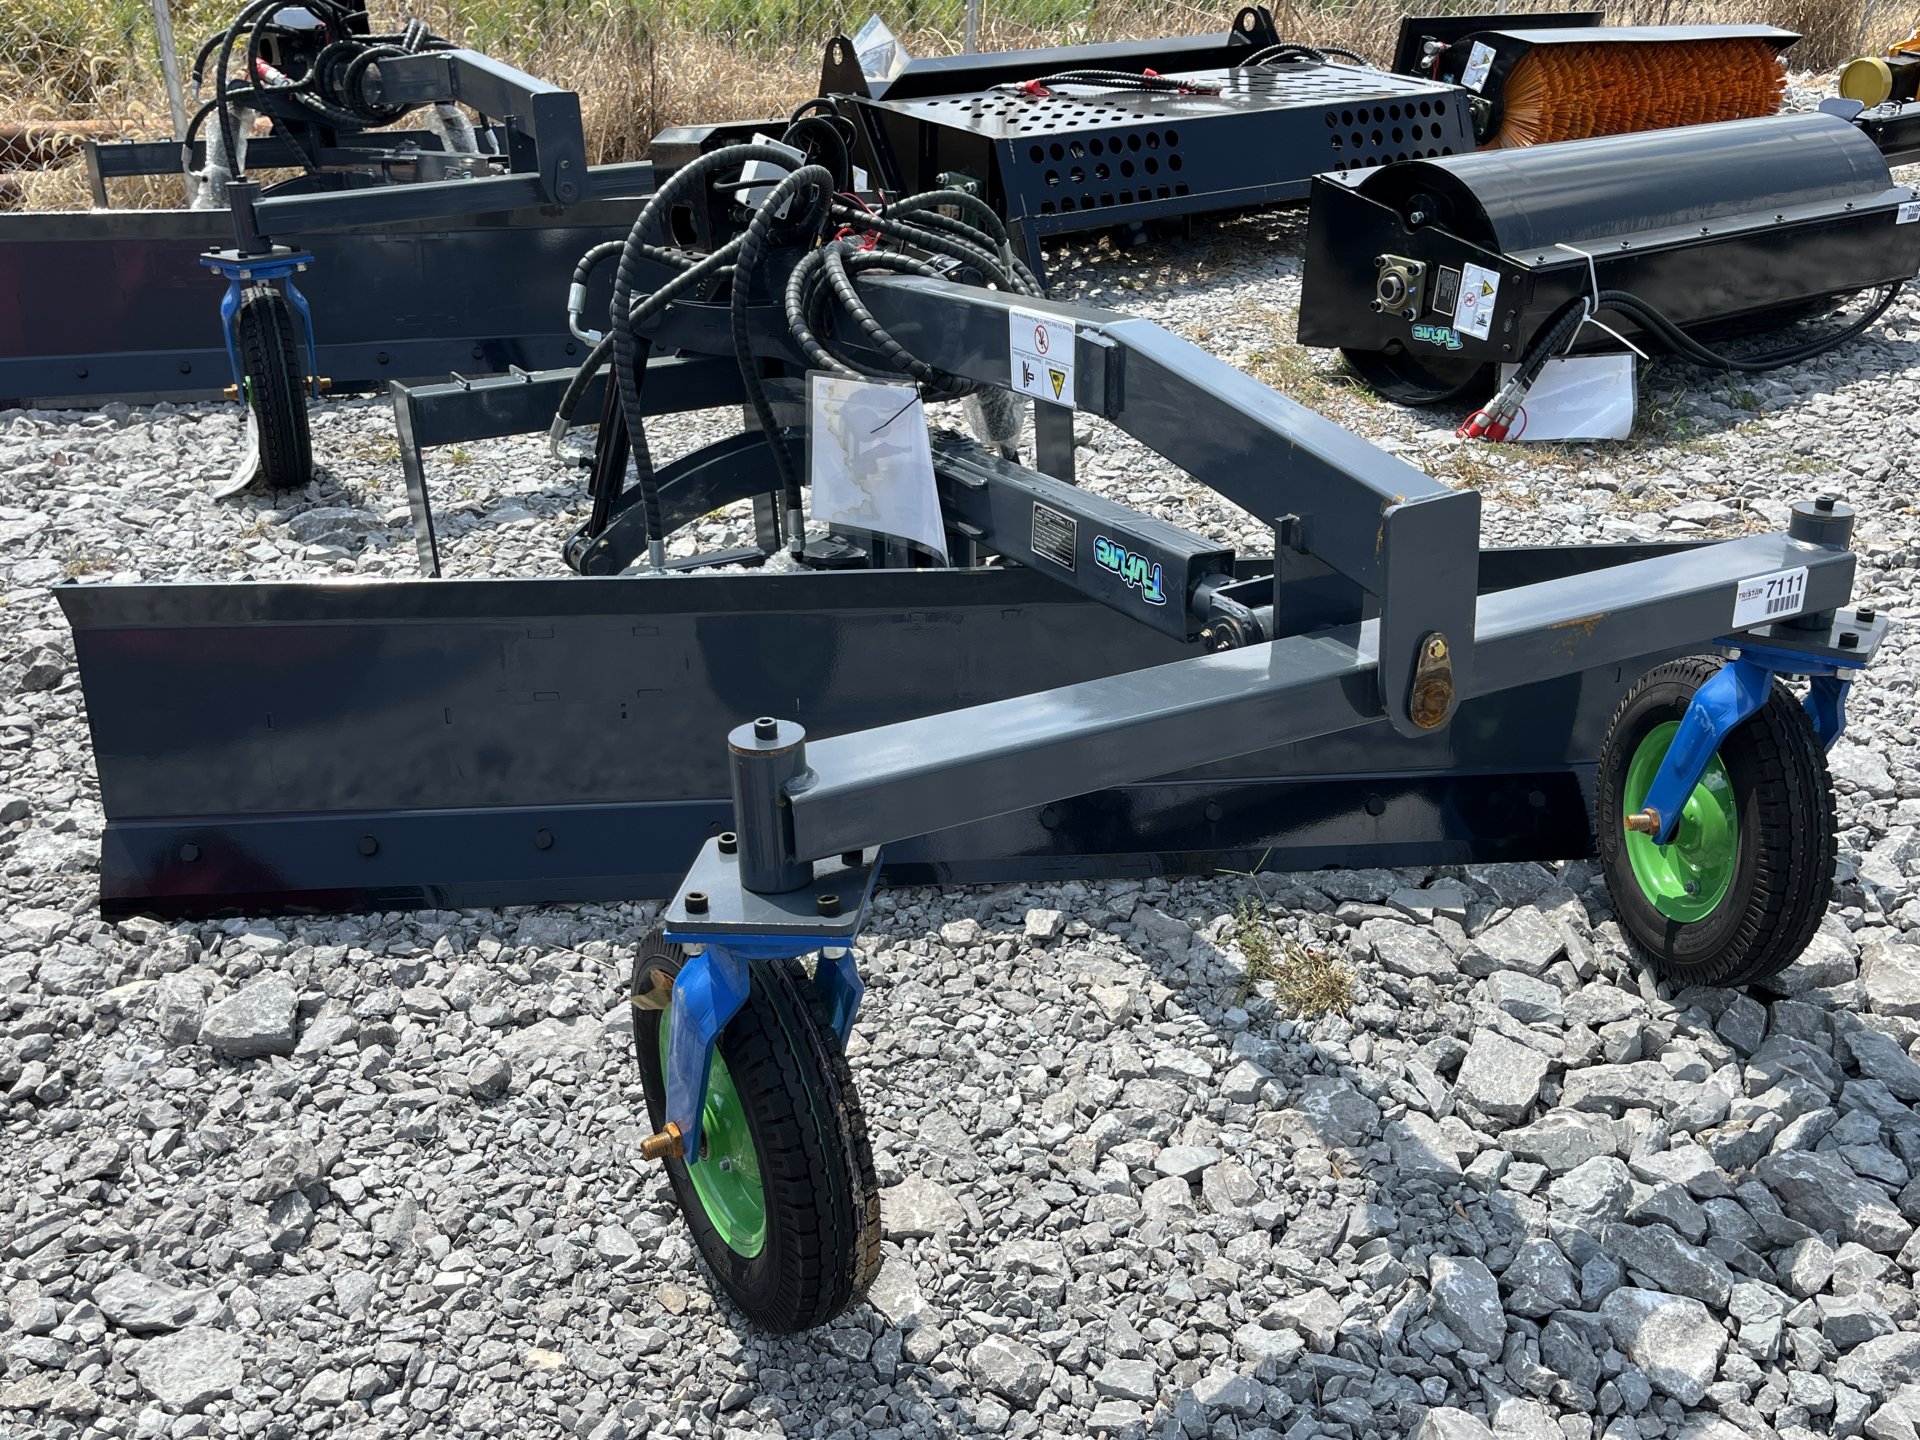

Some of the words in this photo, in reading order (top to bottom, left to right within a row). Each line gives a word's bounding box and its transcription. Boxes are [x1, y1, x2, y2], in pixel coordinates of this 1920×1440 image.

[1412, 324, 1463, 350] Future
[1094, 535, 1166, 605] Future
[1738, 587, 1764, 599] TRISTAR
[1766, 573, 1804, 599] 7111
